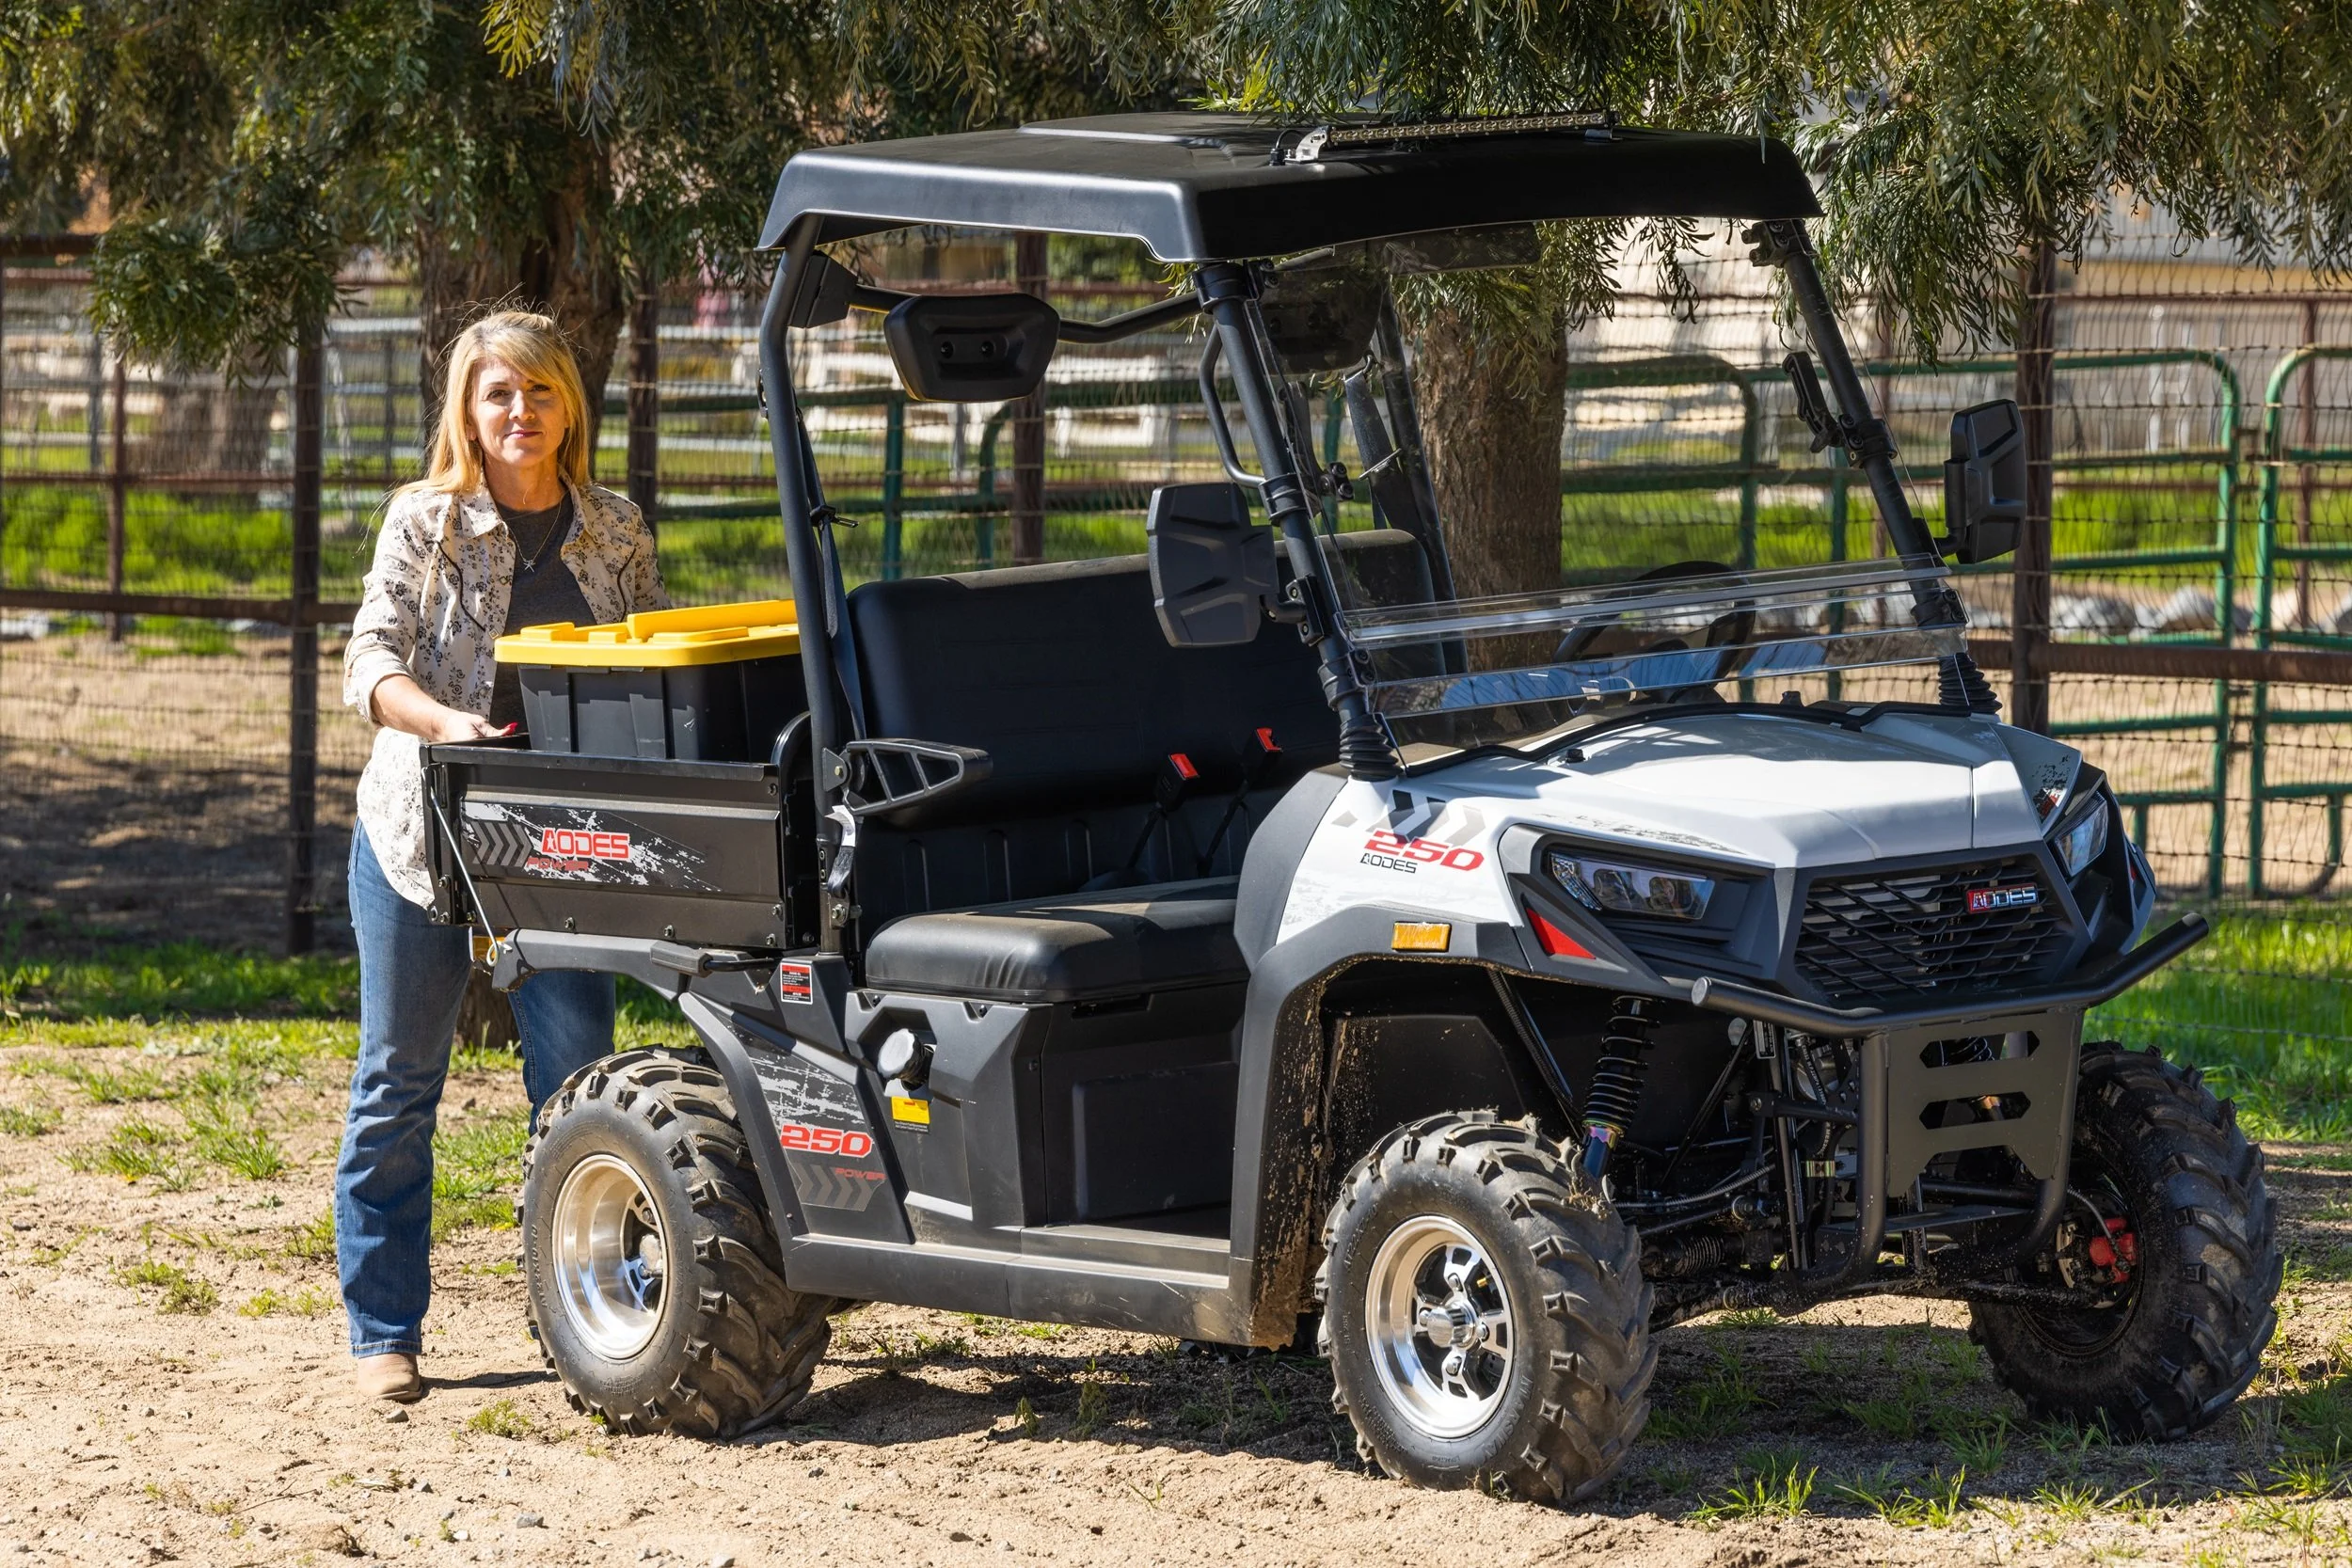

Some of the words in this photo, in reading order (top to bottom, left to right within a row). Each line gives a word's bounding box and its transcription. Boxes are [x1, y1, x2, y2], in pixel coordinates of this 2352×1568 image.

[542, 828, 629, 860] AODES
[1364, 831, 1486, 872] 250
[525, 856, 589, 872] POWER
[1359, 852, 1419, 874] AODES
[1972, 885, 2037, 911] AODES
[780, 1124, 873, 1158] 250
[834, 1167, 886, 1180] POWER
